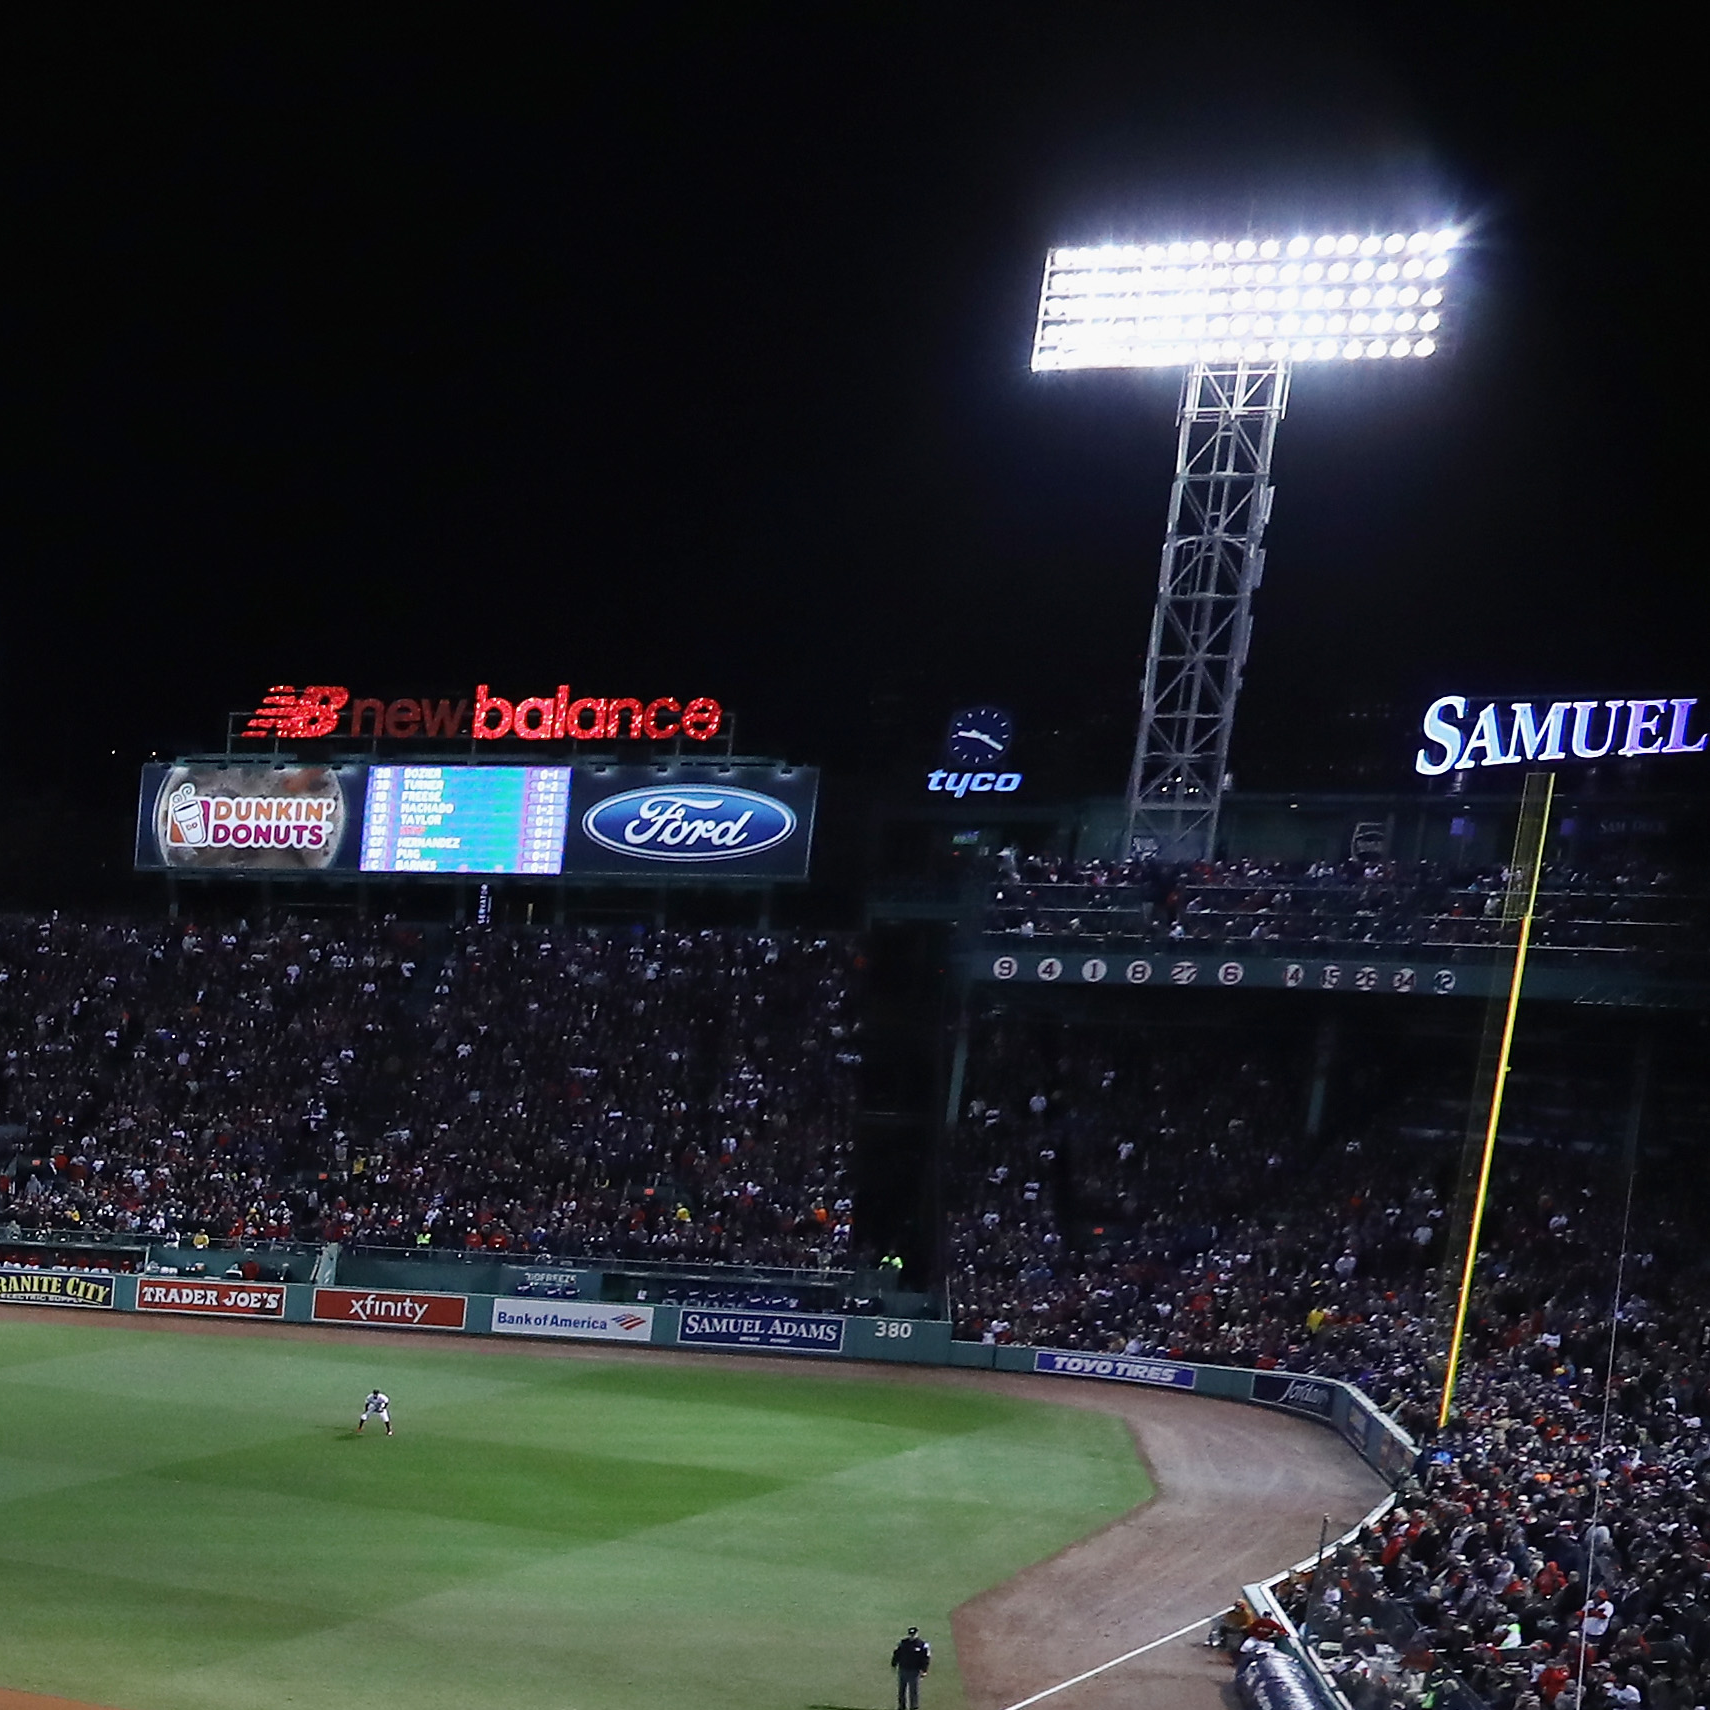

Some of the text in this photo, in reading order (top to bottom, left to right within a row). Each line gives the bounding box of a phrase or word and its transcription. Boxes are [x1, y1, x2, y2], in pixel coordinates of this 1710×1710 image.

[352, 684, 722, 740] new balance
[1416, 695, 1709, 775] SAMUEL
[928, 768, 1023, 798] tyco
[214, 801, 333, 822] DUNKIN'
[401, 804, 455, 814] MACHADO
[401, 815, 443, 826] TAYLOR
[624, 796, 754, 846] Ford
[212, 825, 323, 845] DONUTS
[1000, 960, 1057, 979] 9 4
[65, 1277, 110, 1303] CITY
[142, 1286, 281, 1309] TRADER JOE'S
[349, 1294, 428, 1323] xfinity
[498, 1312, 607, 1330] Bank of America
[685, 1314, 765, 1334] SAMUEL
[768, 1319, 837, 1342] ADAMS
[875, 1322, 912, 1338] 380
[1054, 1356, 1178, 1381] TOYO TIRES
